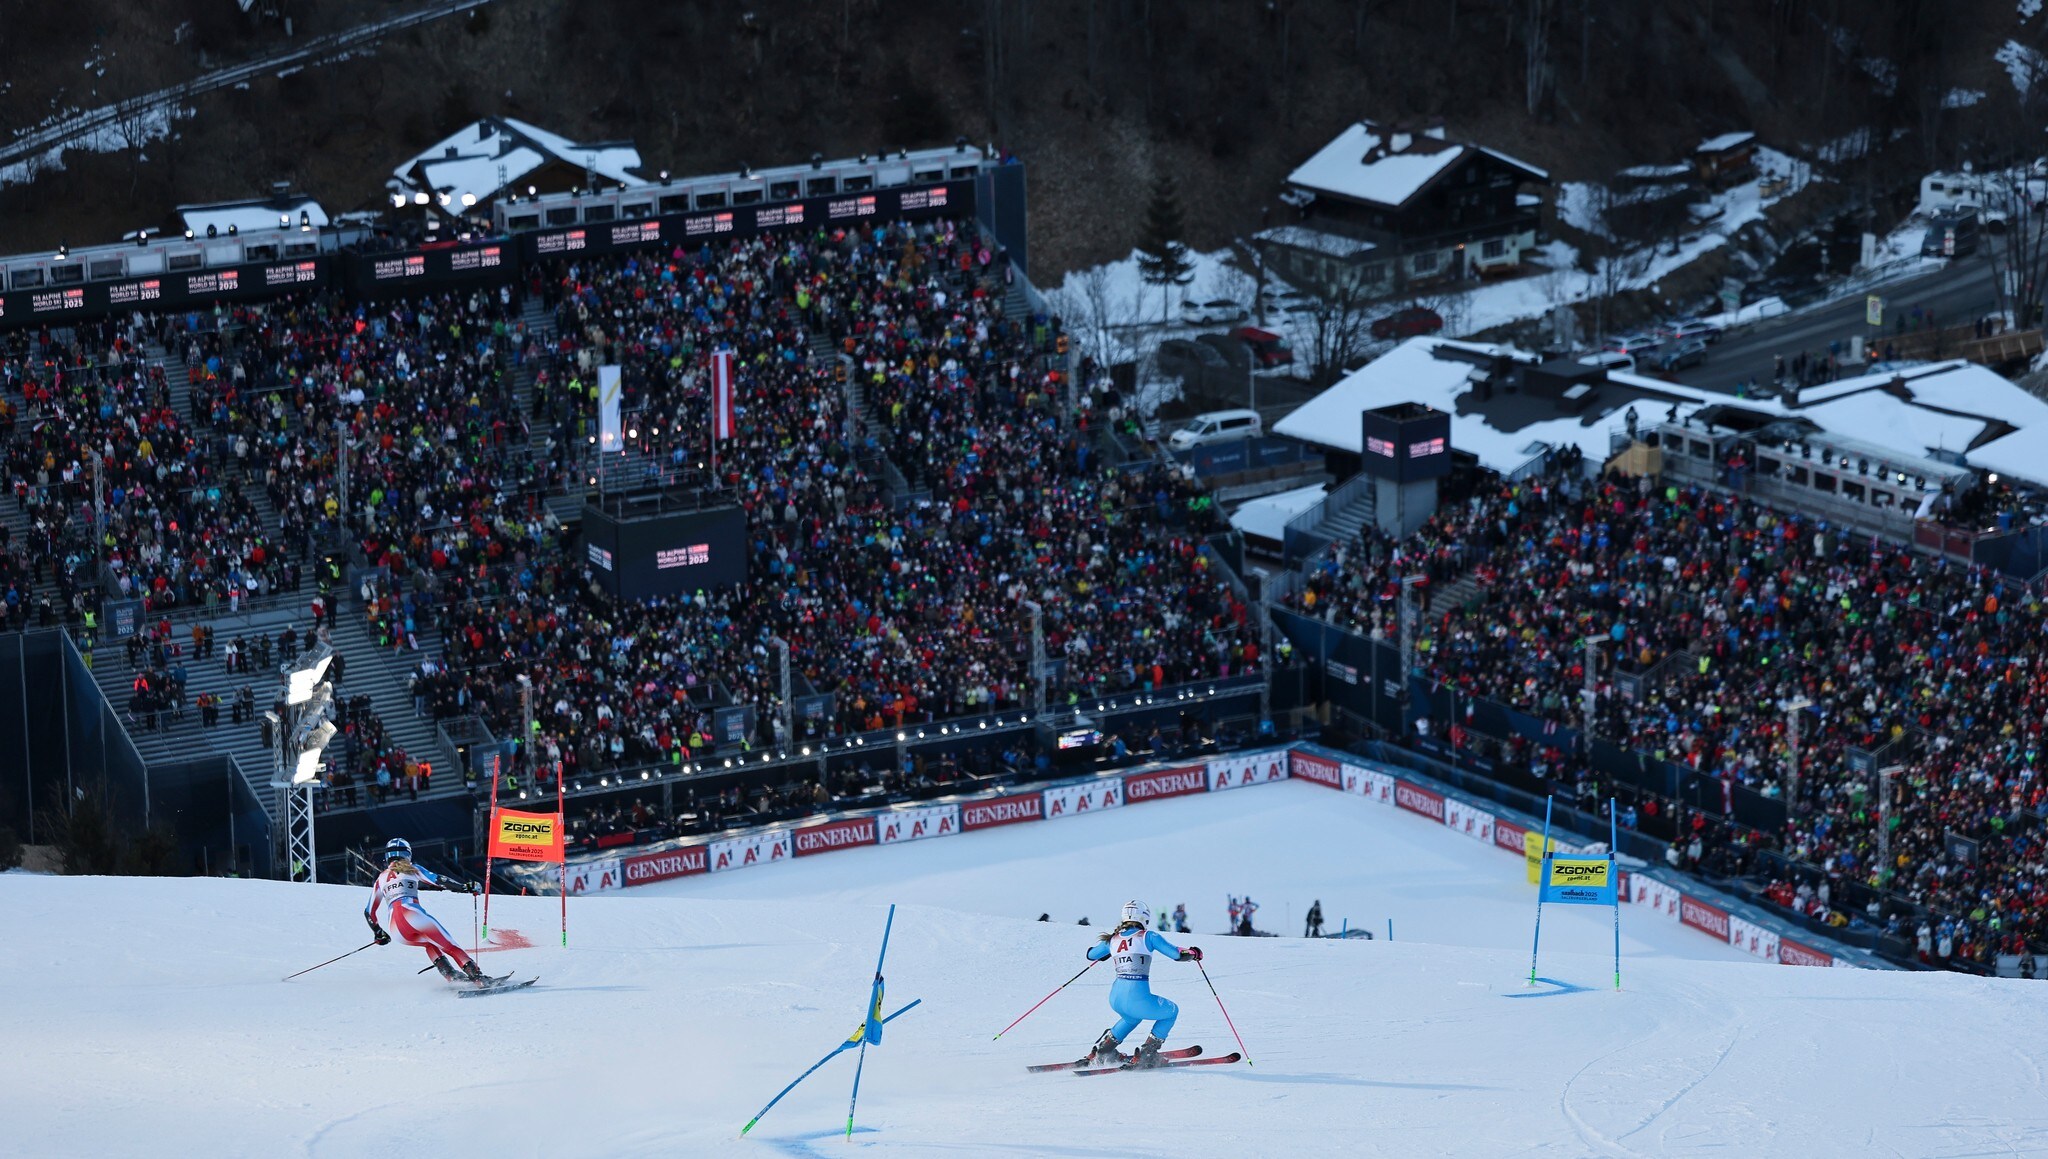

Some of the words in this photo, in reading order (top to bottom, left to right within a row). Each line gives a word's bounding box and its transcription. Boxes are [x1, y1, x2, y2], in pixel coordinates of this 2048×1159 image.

[641, 231, 659, 241] 2025
[567, 240, 585, 250] 2025
[482, 256, 500, 266] 2025
[405, 266, 424, 276] 2025
[198, 274, 216, 282] ALPINE
[296, 271, 315, 282] 2025
[119, 283, 138, 292] ALPINE
[219, 280, 238, 290] 2025
[42, 292, 61, 300] ALPINE
[140, 290, 160, 300] 2025
[64, 298, 83, 308] 2025
[689, 555, 709, 565] 2025
[1217, 769, 1231, 788] A1
[1243, 765, 1257, 784] A1
[1269, 760, 1283, 779] A1
[1128, 771, 1204, 798] GENERALI
[1051, 797, 1066, 816] A1
[1077, 793, 1092, 812] A1
[1103, 788, 1118, 807] A1
[1397, 786, 1443, 819] GENERALI
[964, 798, 1040, 825] GENERALI
[504, 822, 551, 833] ZGONC
[885, 822, 900, 841] A1
[912, 818, 927, 838] A1
[939, 814, 954, 834] A1
[797, 823, 874, 850] GENERALI
[717, 849, 732, 870] A1
[744, 844, 760, 865] A1
[772, 840, 787, 859] A1
[626, 852, 705, 880] GENERALI
[1555, 866, 1604, 874] ZGONC
[573, 873, 589, 893] A1
[601, 869, 616, 889] A1
[388, 882, 404, 891] FRA
[1117, 938, 1132, 953] A1
[1140, 956, 1144, 964] 1
